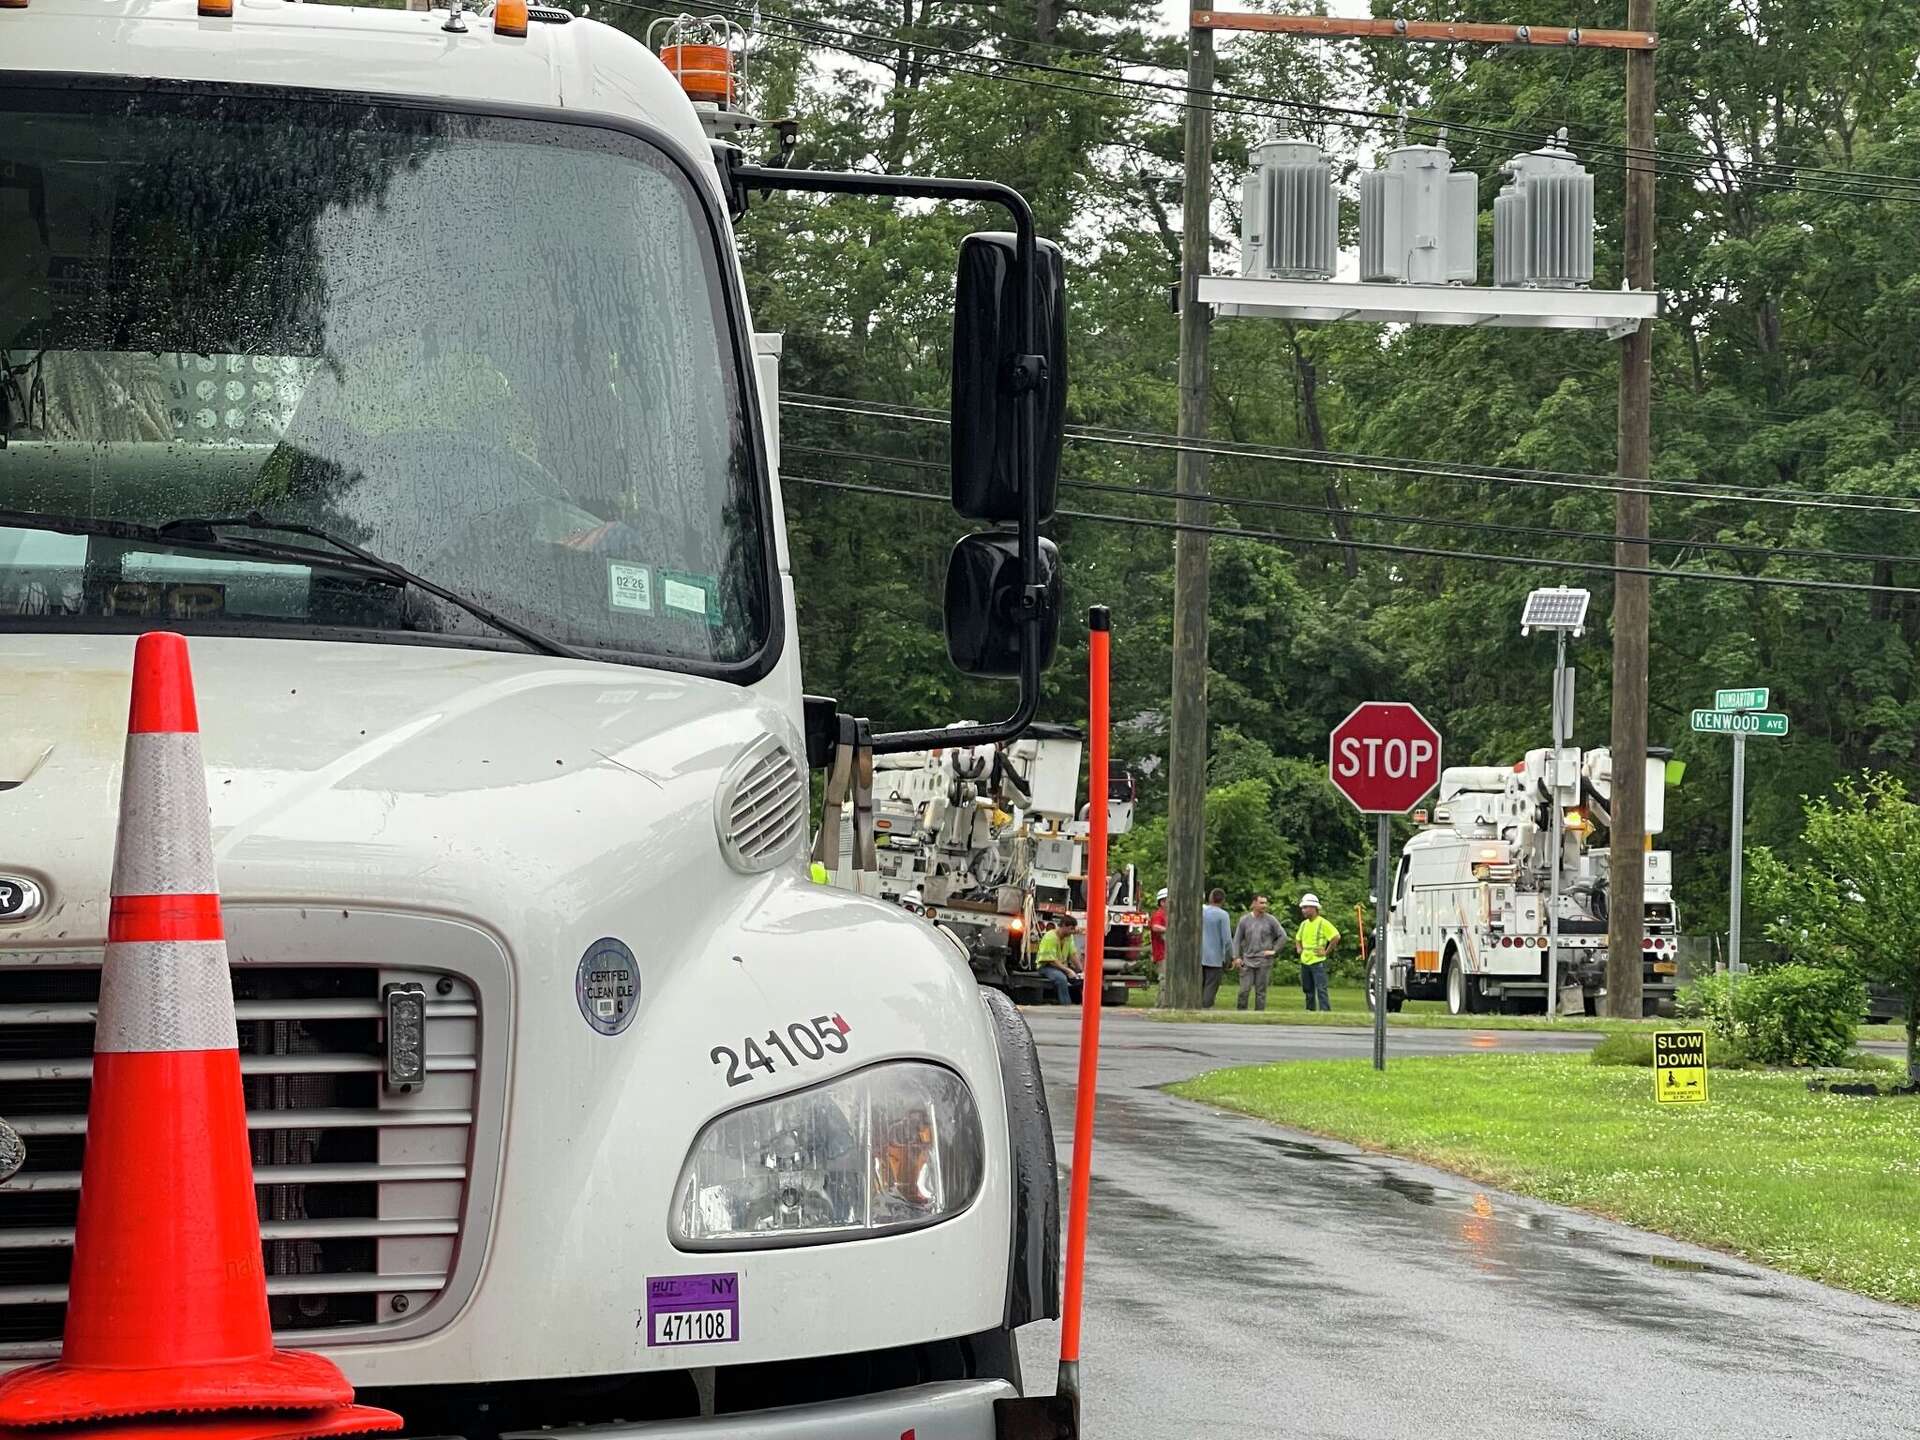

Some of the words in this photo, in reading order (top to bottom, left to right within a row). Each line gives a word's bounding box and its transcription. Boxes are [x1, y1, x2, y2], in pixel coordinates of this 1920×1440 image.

[1696, 712, 1760, 731] KENWOOD
[1766, 720, 1784, 730] AVE
[1338, 737, 1433, 779] STOP
[587, 986, 614, 999] CLEAN
[1657, 1035, 1702, 1049] SLOW
[710, 1015, 849, 1088] 24105
[1657, 1053, 1703, 1066] DOWN
[651, 1280, 677, 1292] HUT
[711, 1277, 736, 1295] NY
[663, 1312, 725, 1341] 471108
